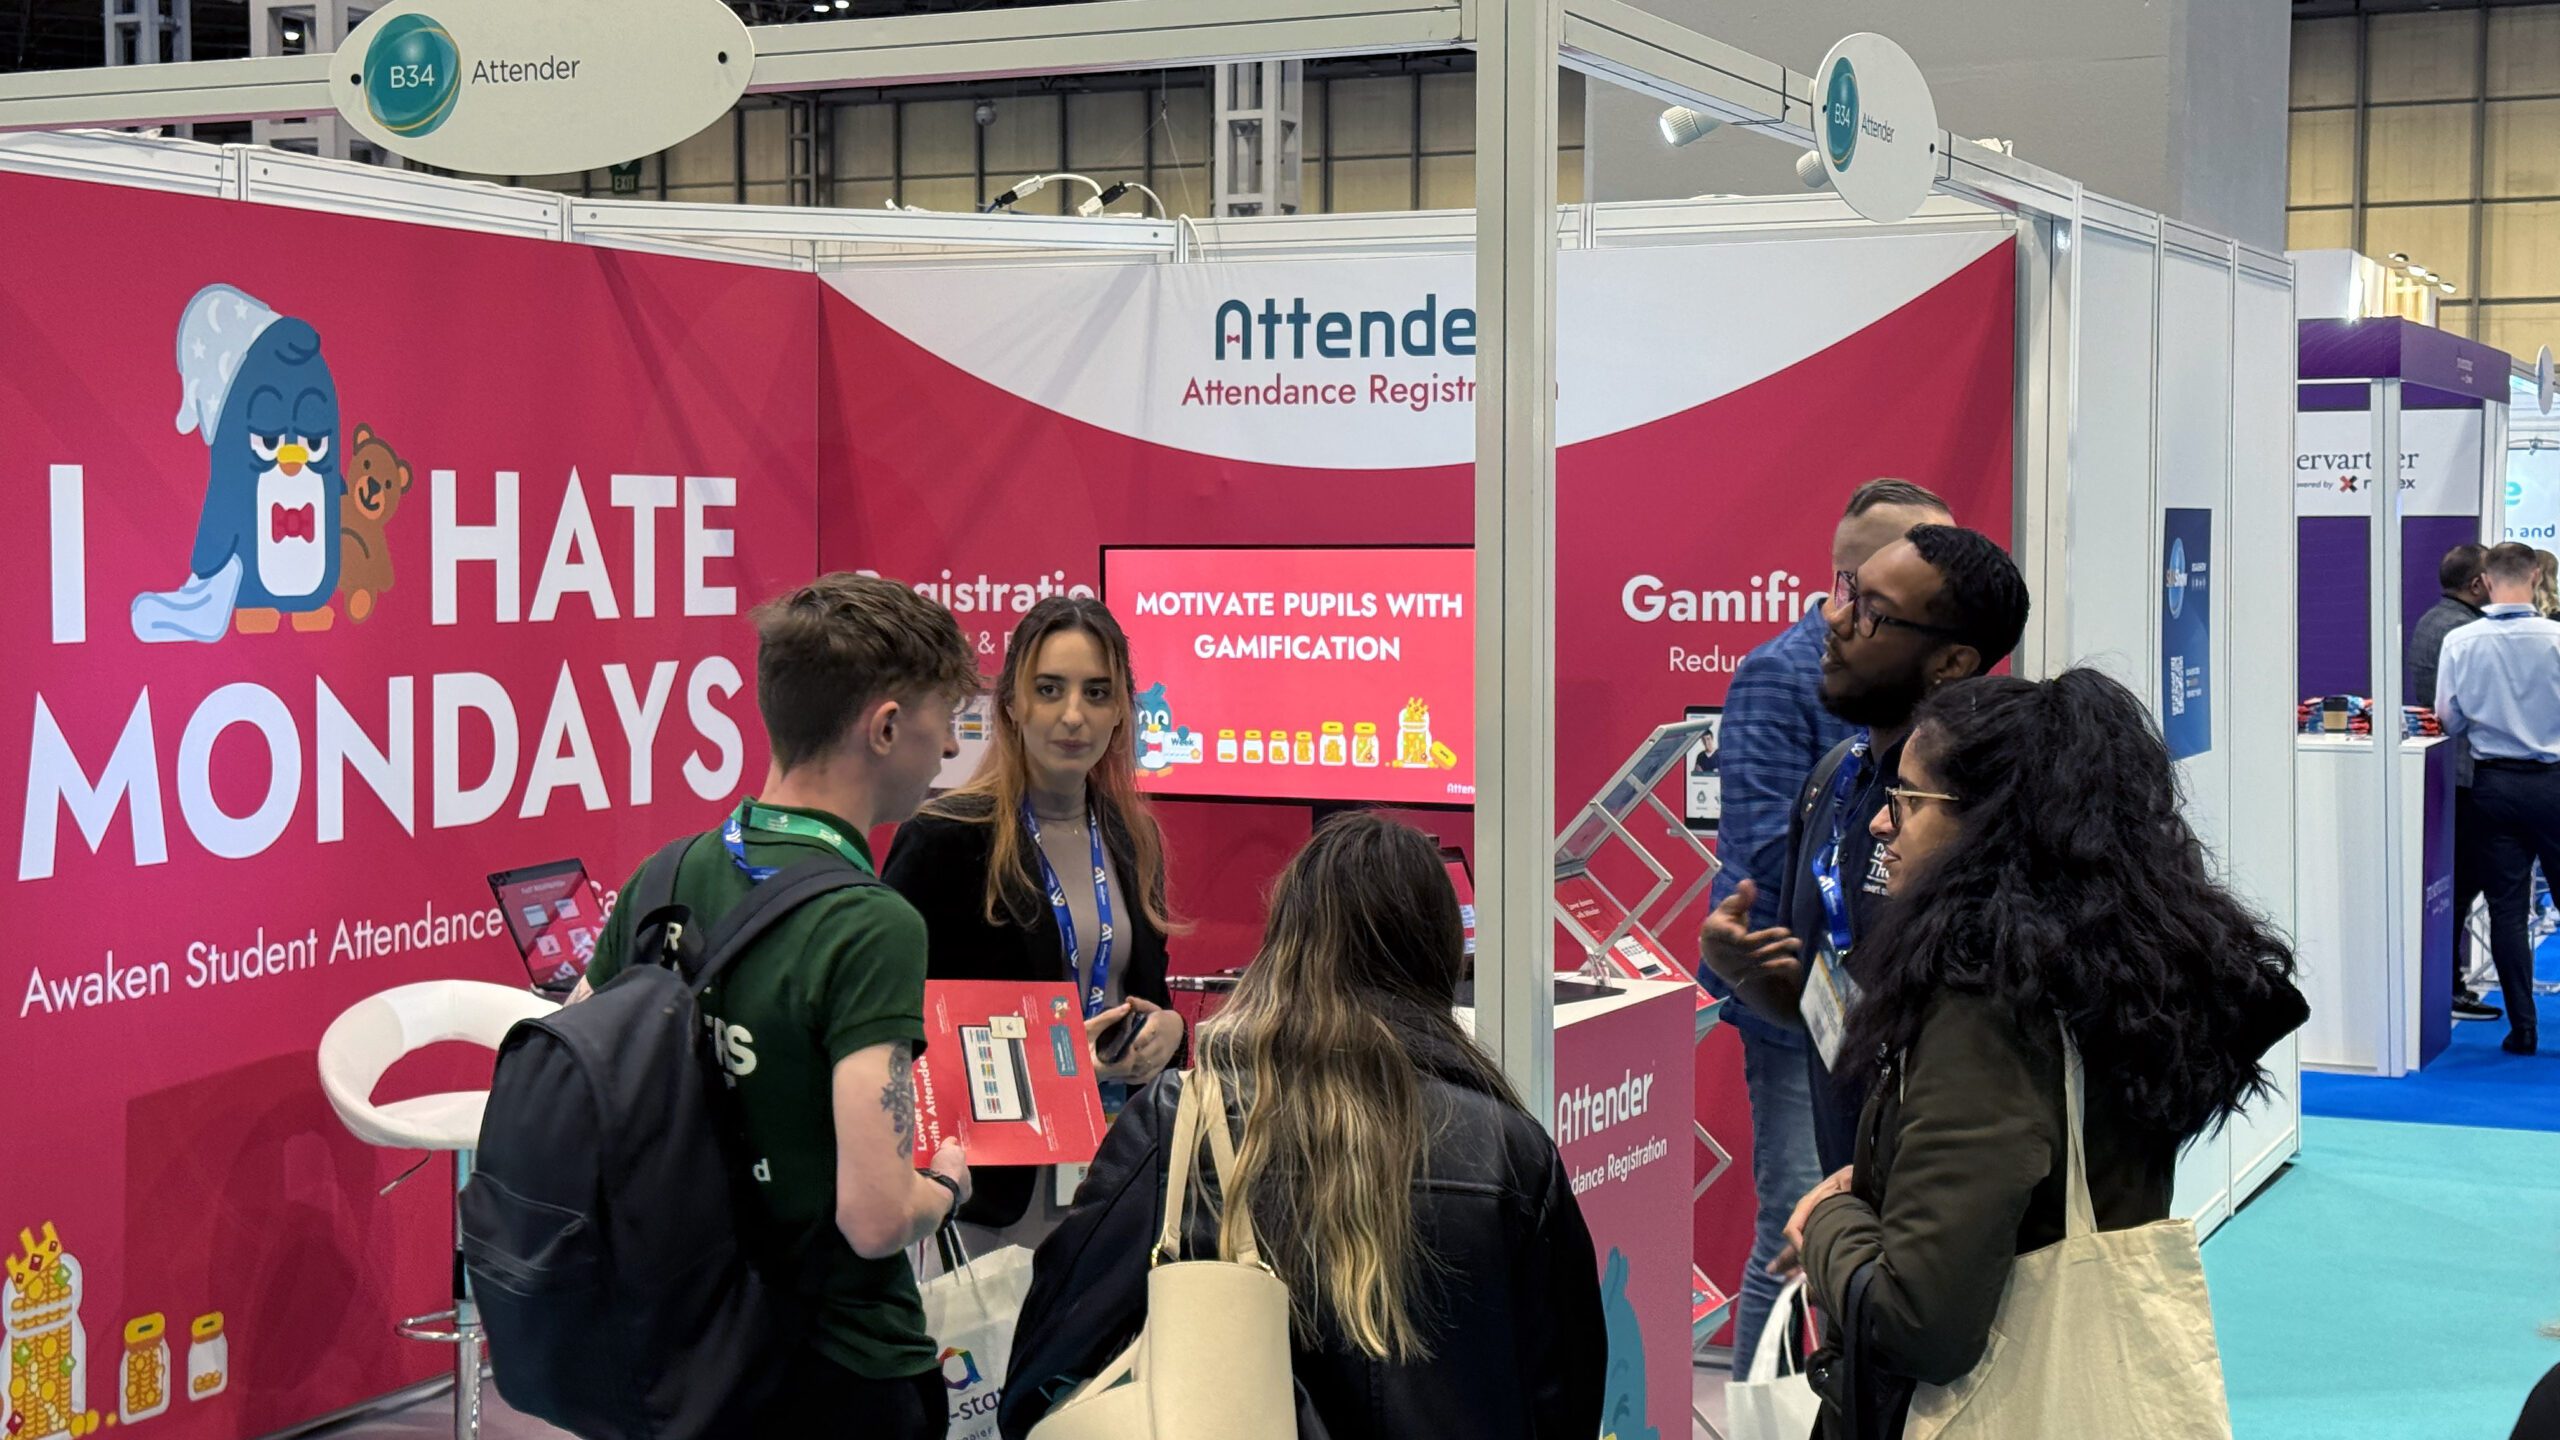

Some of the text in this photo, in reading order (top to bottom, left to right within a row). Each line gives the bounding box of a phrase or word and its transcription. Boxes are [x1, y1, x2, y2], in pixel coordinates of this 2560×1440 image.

[390, 56, 581, 89] B34 Attender
[1834, 103, 1895, 143] B34 Attender
[614, 174, 636, 192] EXIT
[1215, 293, 1476, 361] Attende
[1181, 373, 1357, 406] Attendance
[2323, 480, 2334, 491] by
[2519, 523, 2556, 539] and
[50, 464, 738, 644] I HATE
[1135, 591, 1463, 618] MOTIVATE PUPILS WITH
[1621, 570, 1831, 623] Gamific
[1194, 634, 1401, 662] GAMIFICATION
[1171, 737, 1194, 747] Week
[17, 655, 745, 882] MONDAYS
[1447, 783, 1476, 795] Atten
[20, 900, 504, 1018] Awaken Student Attendance
[1557, 1068, 1654, 1148] Attender
[914, 1108, 928, 1152] Lower
[1571, 1135, 1668, 1195] dance Registration
[948, 1386, 1002, 1427] -sta
